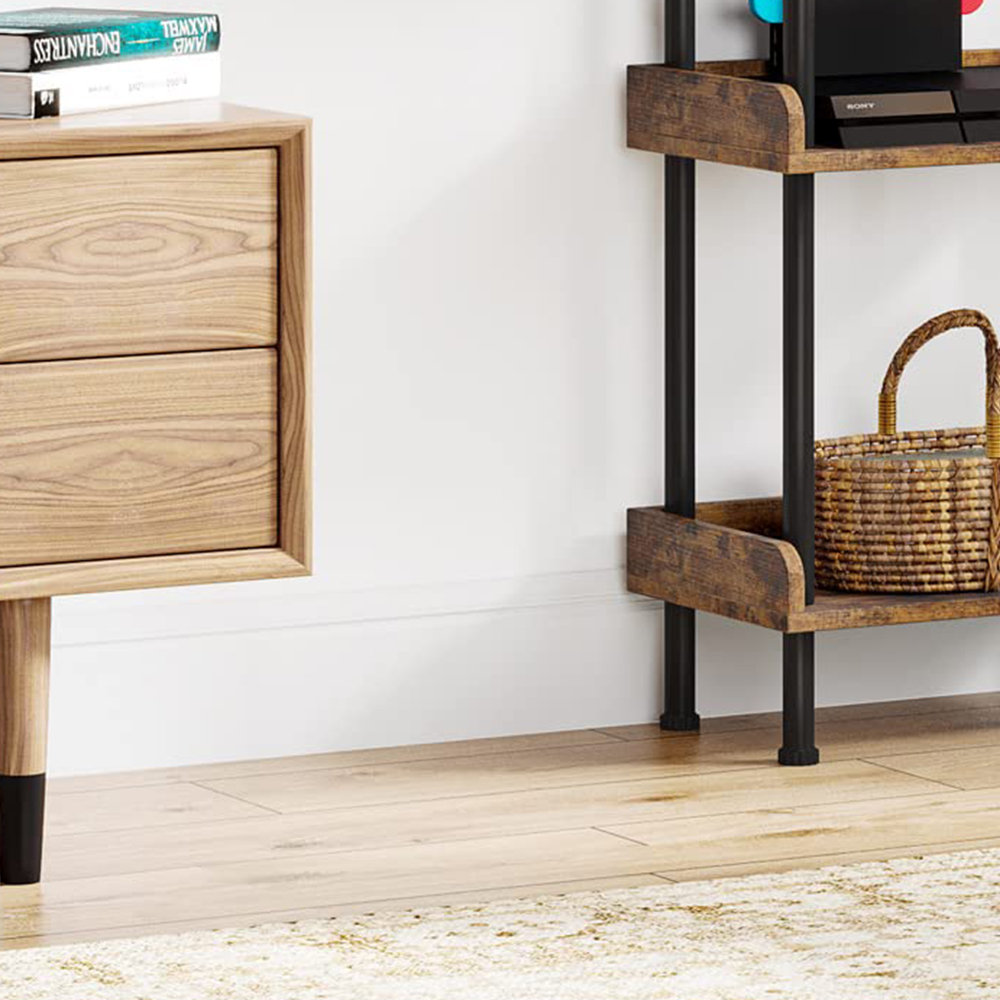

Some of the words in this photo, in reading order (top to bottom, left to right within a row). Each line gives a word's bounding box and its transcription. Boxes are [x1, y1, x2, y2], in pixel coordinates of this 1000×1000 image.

[160, 15, 218, 38] MAXWELL
[33, 31, 121, 64] ENCHANTRESS
[172, 32, 208, 55] JAMES
